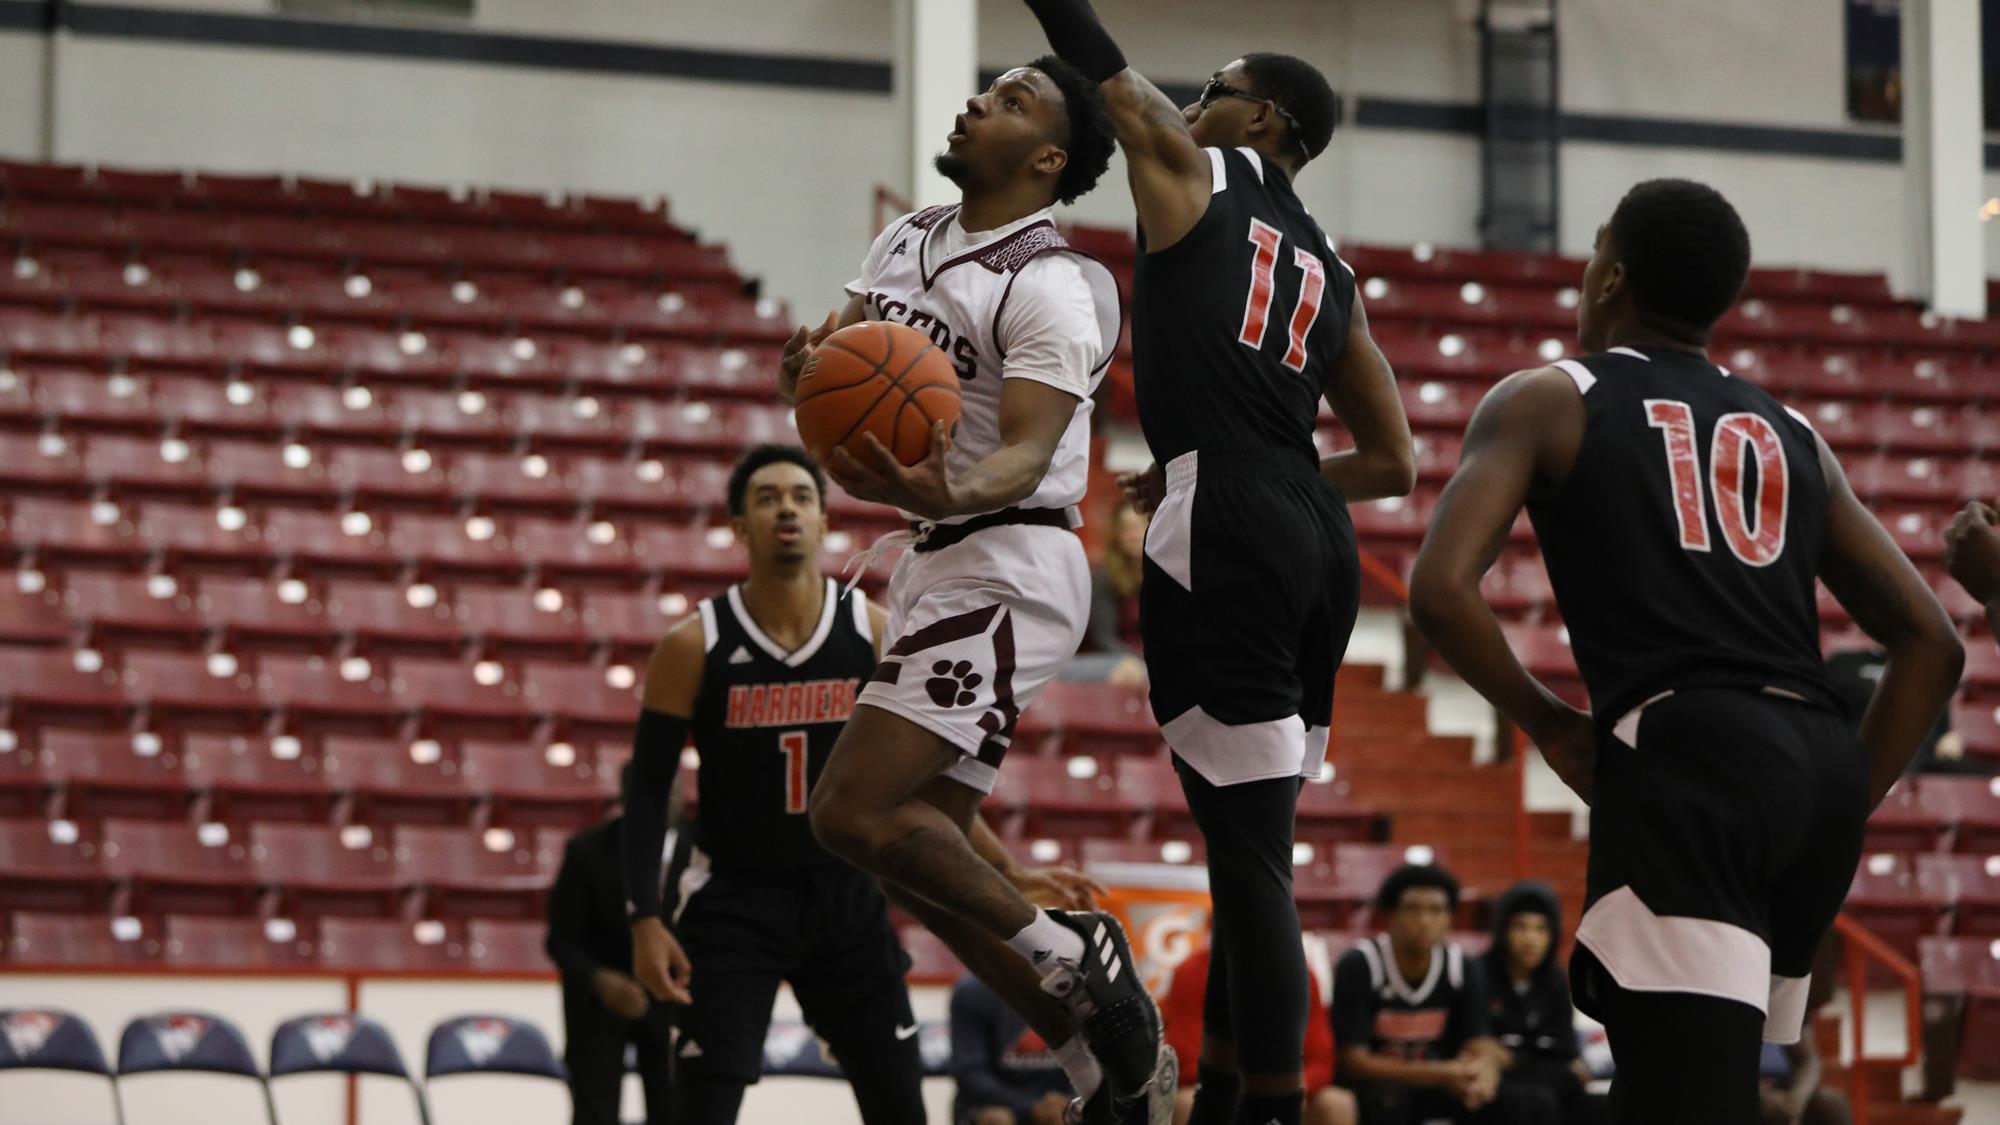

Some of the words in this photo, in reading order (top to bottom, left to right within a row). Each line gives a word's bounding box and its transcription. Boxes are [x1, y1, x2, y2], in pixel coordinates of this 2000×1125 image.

[1238, 217, 1325, 373] 11
[1643, 399, 1789, 567] 10
[779, 731, 808, 814] 1
